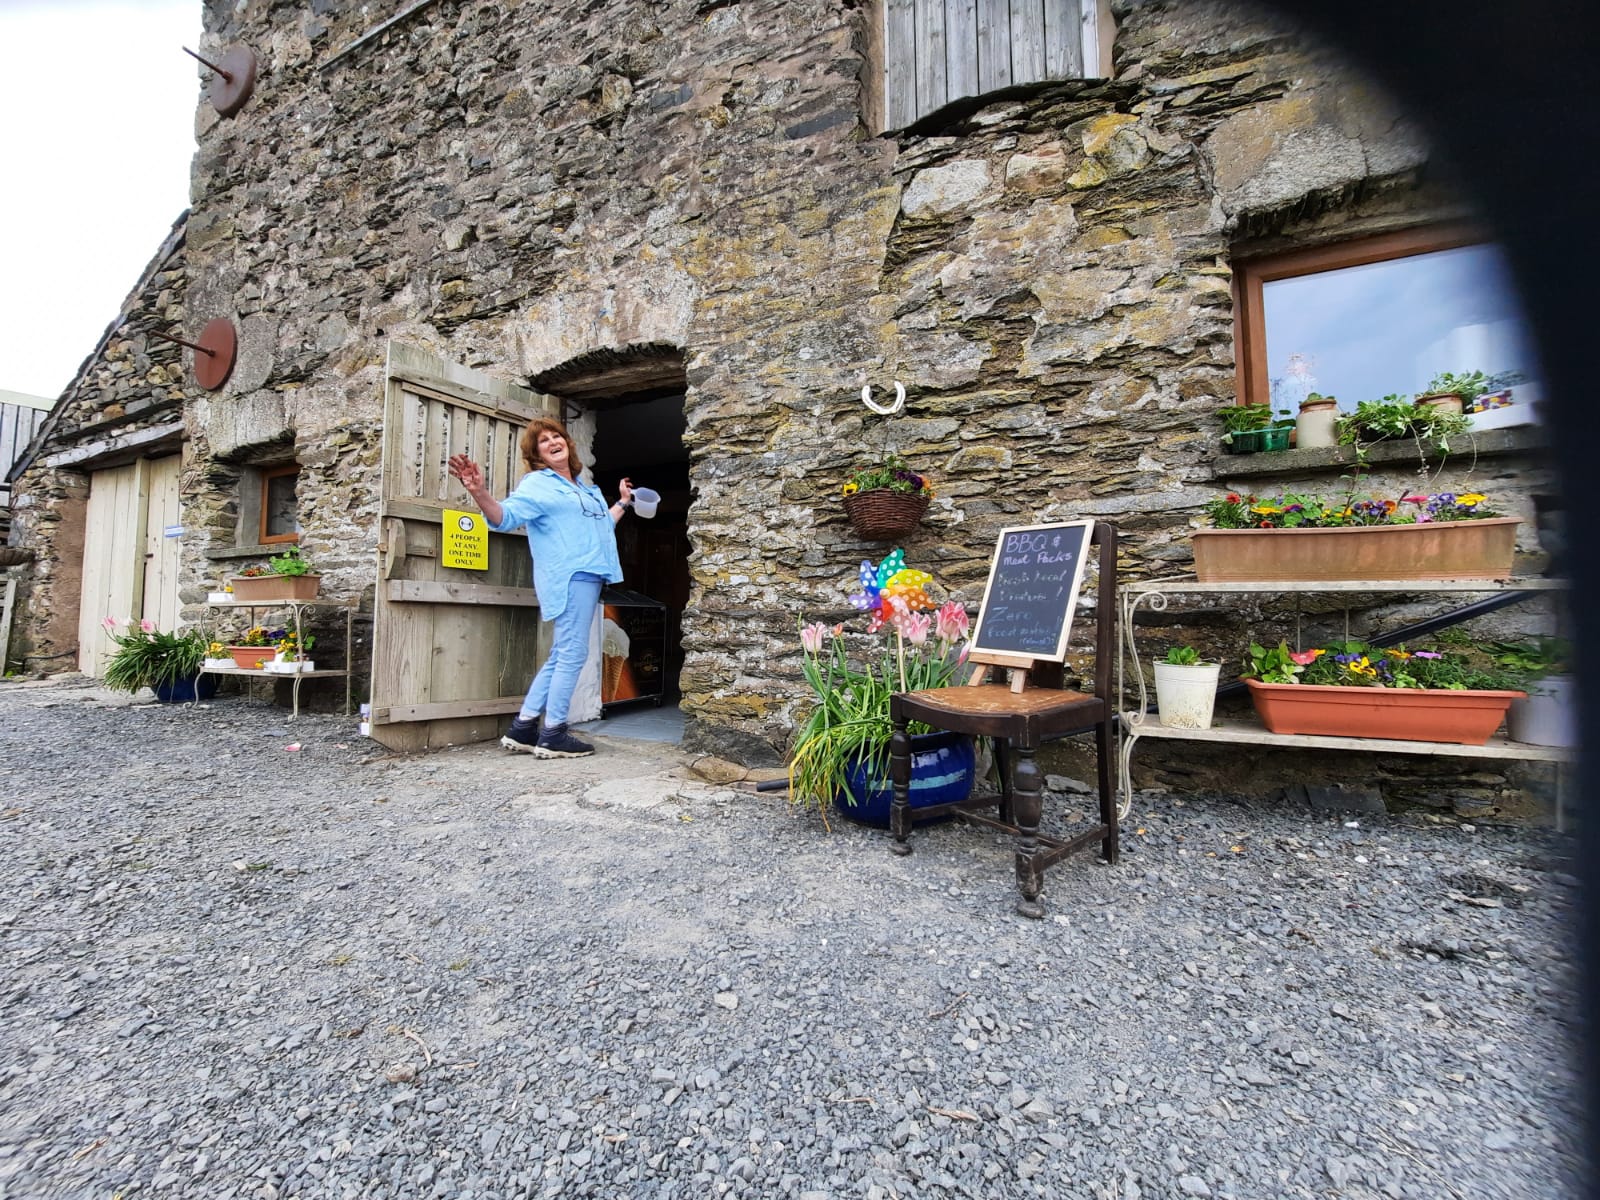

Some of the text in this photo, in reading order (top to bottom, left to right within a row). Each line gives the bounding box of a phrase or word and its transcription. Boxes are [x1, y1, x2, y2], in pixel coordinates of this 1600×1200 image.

[455, 534, 481, 542] PEOPLE
[1006, 533, 1047, 553] BBQ
[1037, 551, 1073, 564] Packs
